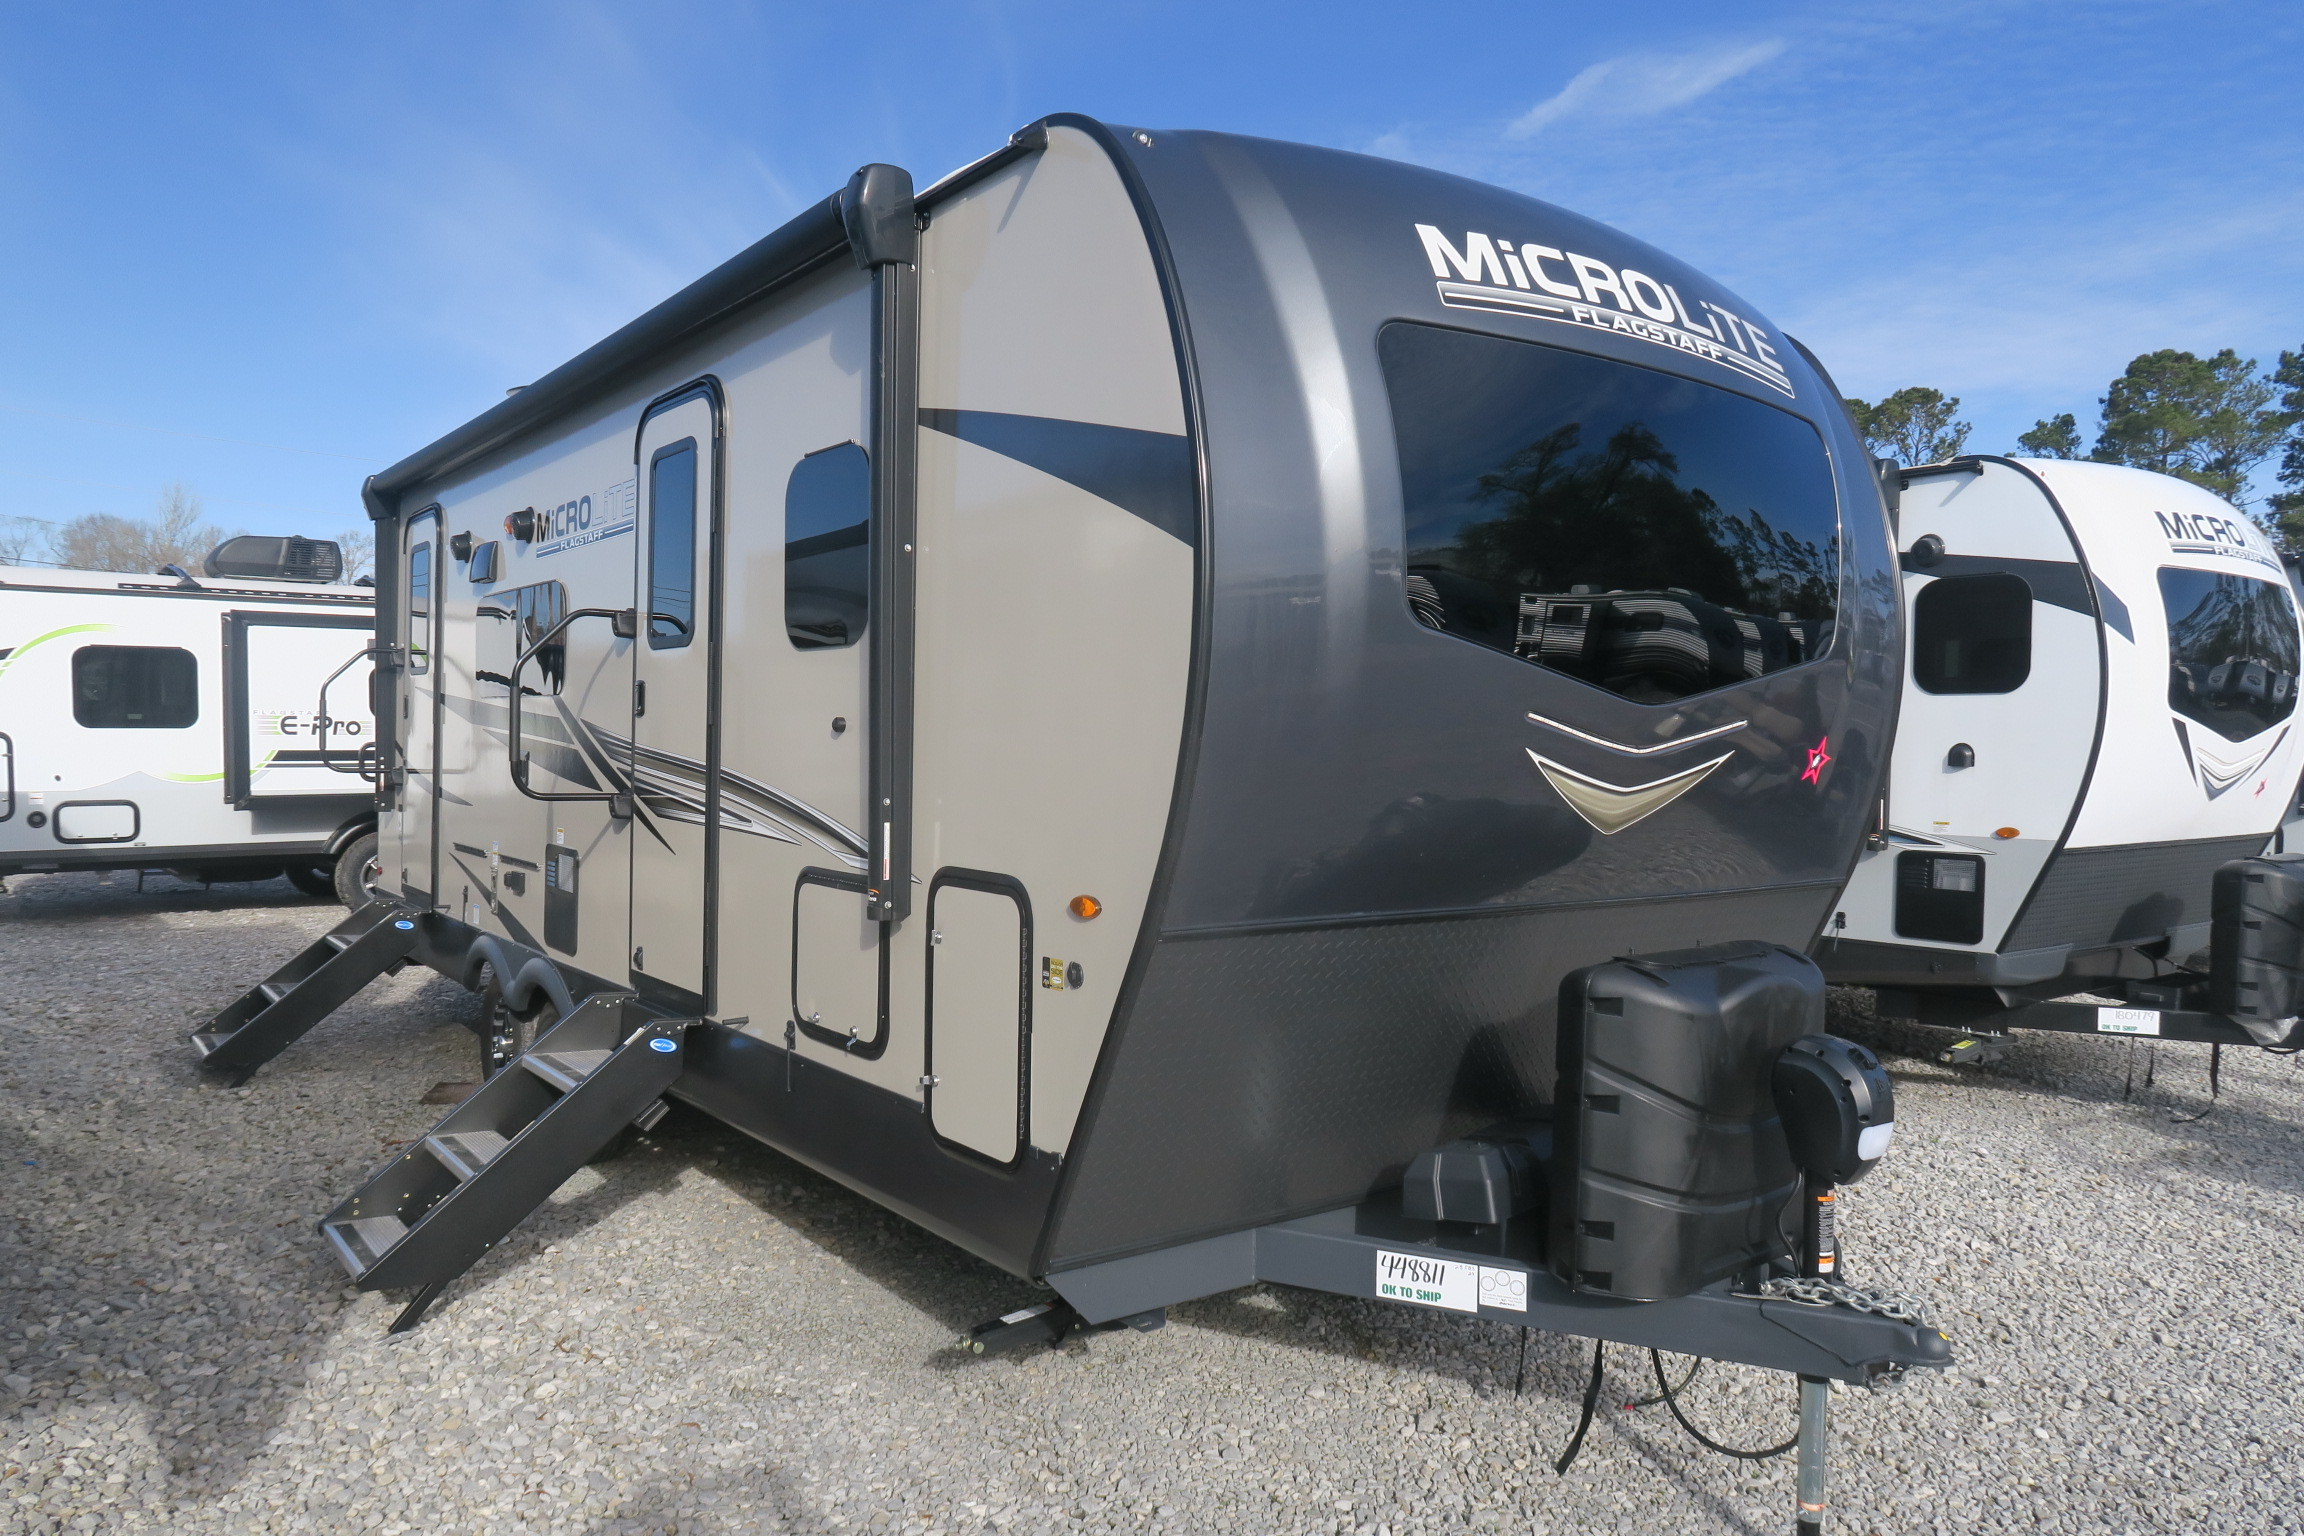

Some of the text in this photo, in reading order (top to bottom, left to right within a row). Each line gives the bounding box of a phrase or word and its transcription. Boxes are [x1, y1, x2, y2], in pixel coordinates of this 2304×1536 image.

[1571, 304, 1723, 361] FLAGSTAFF
[560, 529, 604, 551] FLAGSTAFF
[280, 715, 362, 736] E-Pro
[1381, 1283, 1442, 1303] OK TO SHIP
